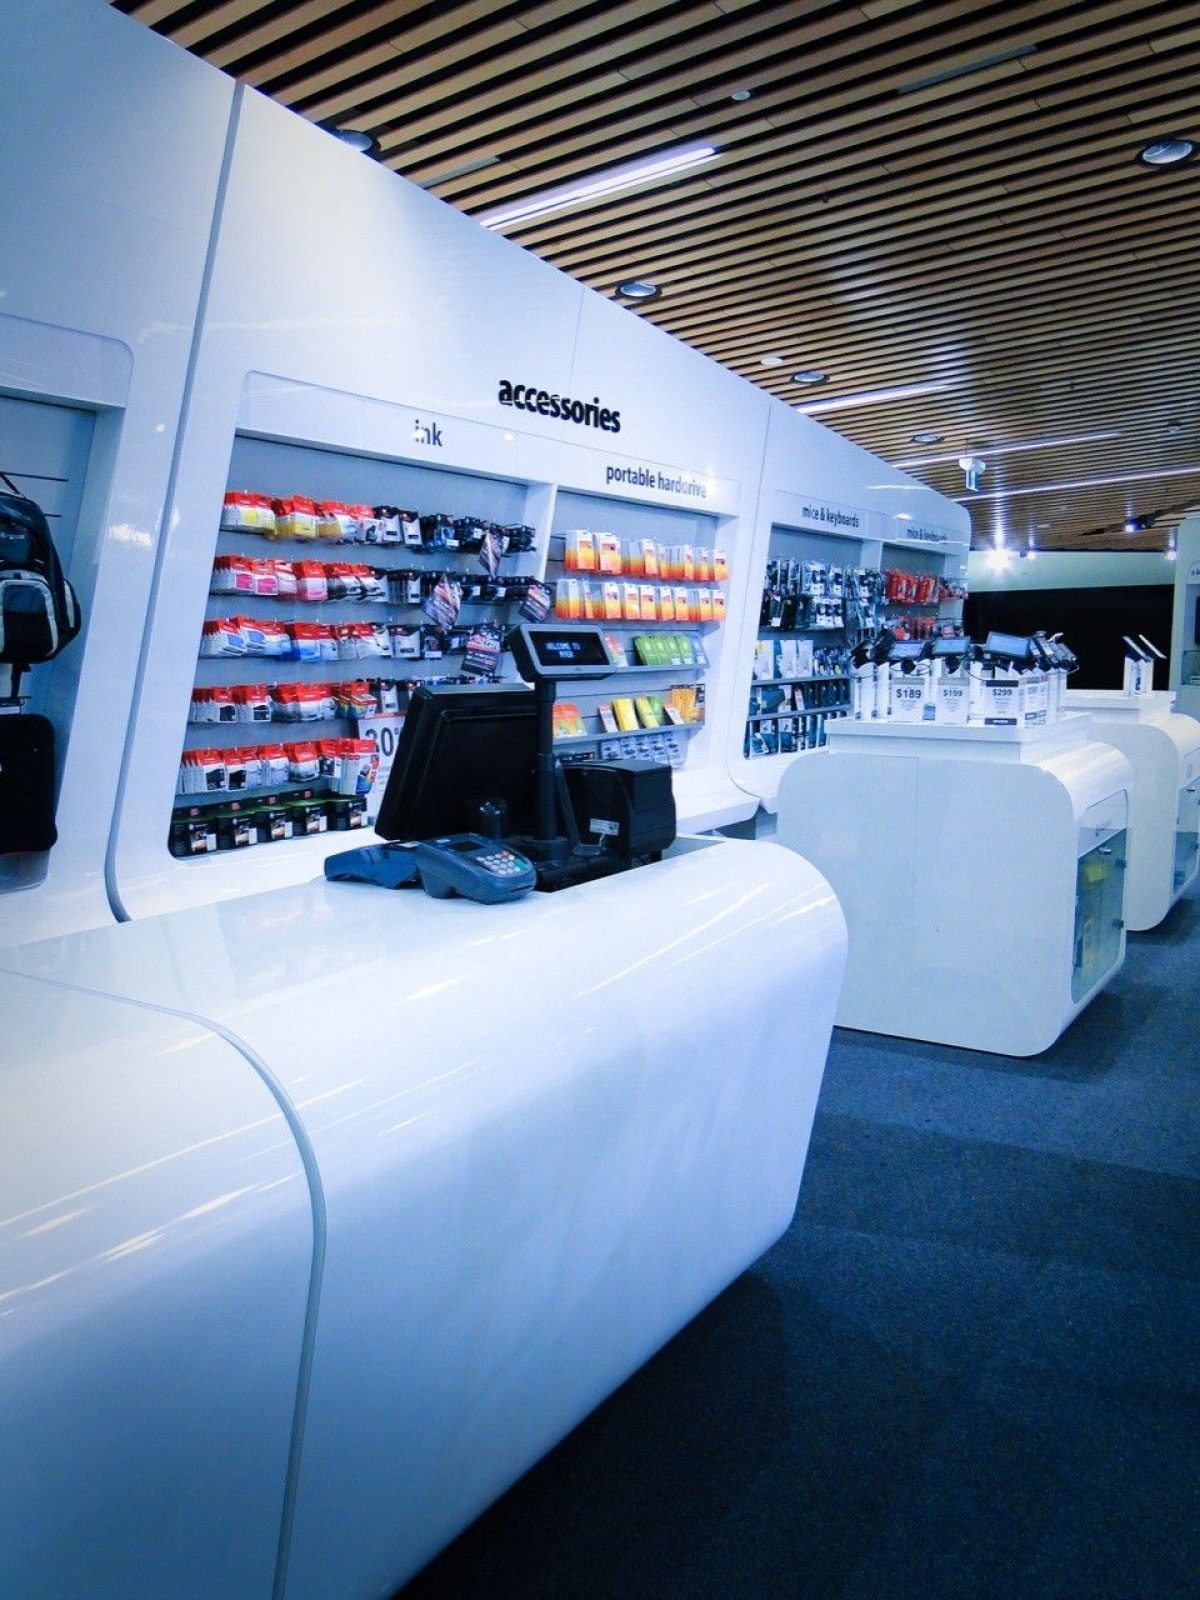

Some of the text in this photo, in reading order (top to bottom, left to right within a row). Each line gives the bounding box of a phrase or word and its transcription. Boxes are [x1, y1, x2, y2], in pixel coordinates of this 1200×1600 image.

[498, 379, 621, 433] accessories
[415, 419, 443, 447] ink
[606, 465, 656, 489] portable
[802, 504, 860, 528] mice & keyboards
[896, 688, 922, 699] $189
